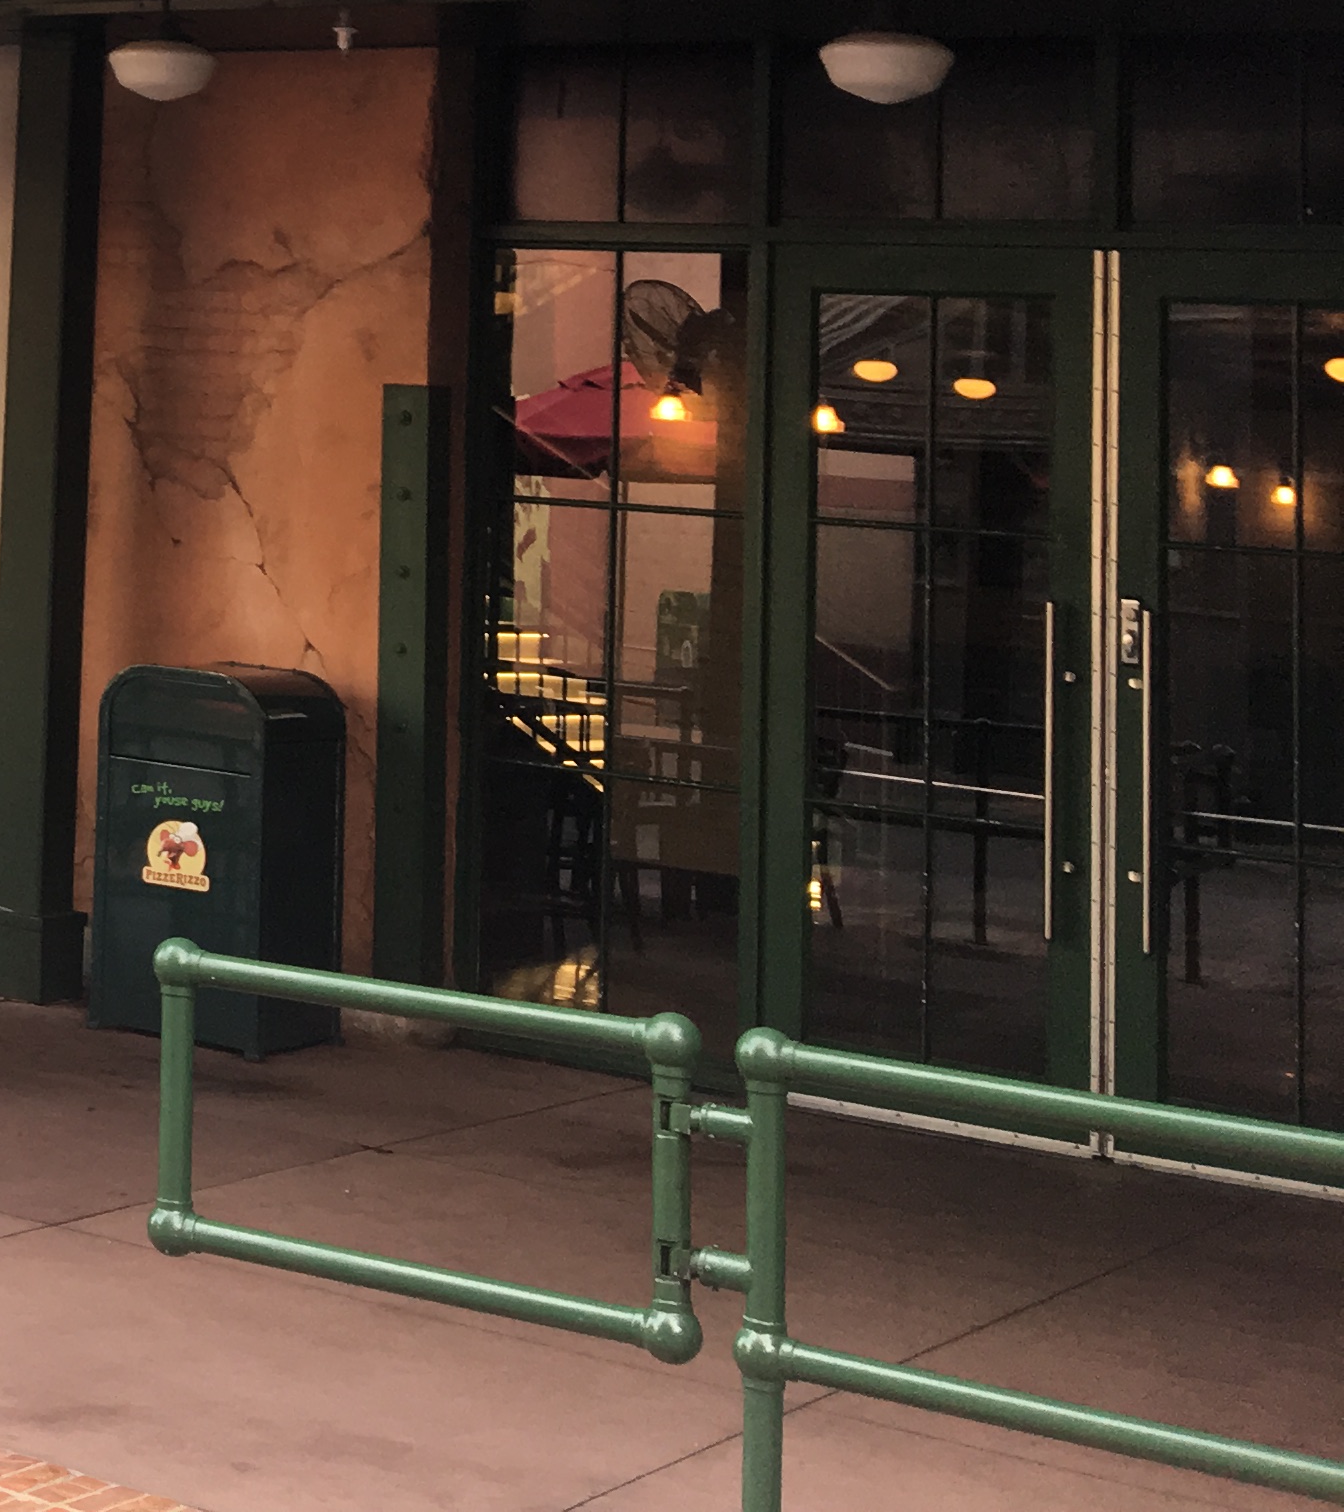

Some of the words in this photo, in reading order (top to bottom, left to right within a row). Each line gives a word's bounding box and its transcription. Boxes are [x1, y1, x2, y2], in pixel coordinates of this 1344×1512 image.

[153, 796, 189, 809] youse
[191, 798, 225, 813] guys!
[145, 869, 207, 887] PIZZERIZZO
